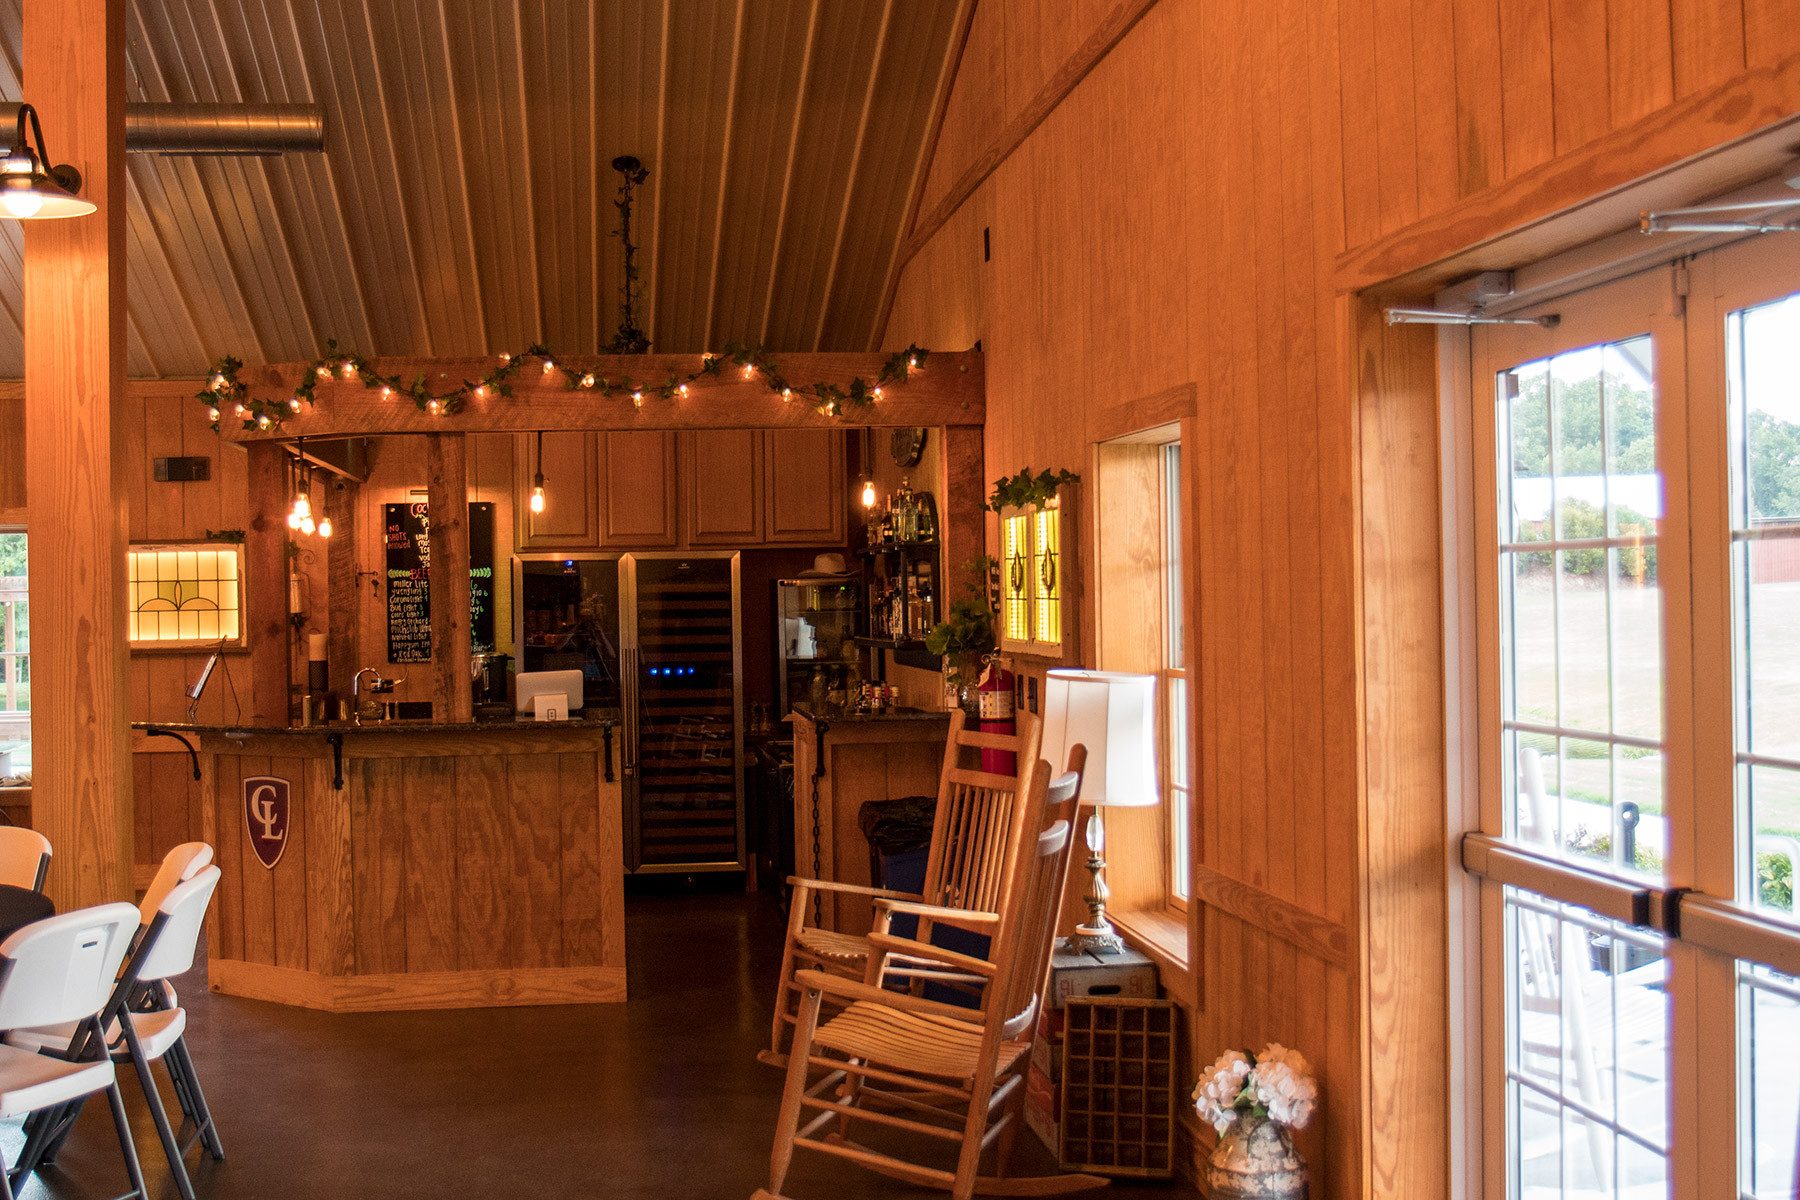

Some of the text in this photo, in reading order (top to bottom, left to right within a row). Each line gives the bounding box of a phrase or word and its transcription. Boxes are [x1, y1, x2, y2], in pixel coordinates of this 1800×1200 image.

[389, 524, 400, 533] NO
[388, 532, 407, 541] SHOTS
[410, 568, 430, 580] BEE
